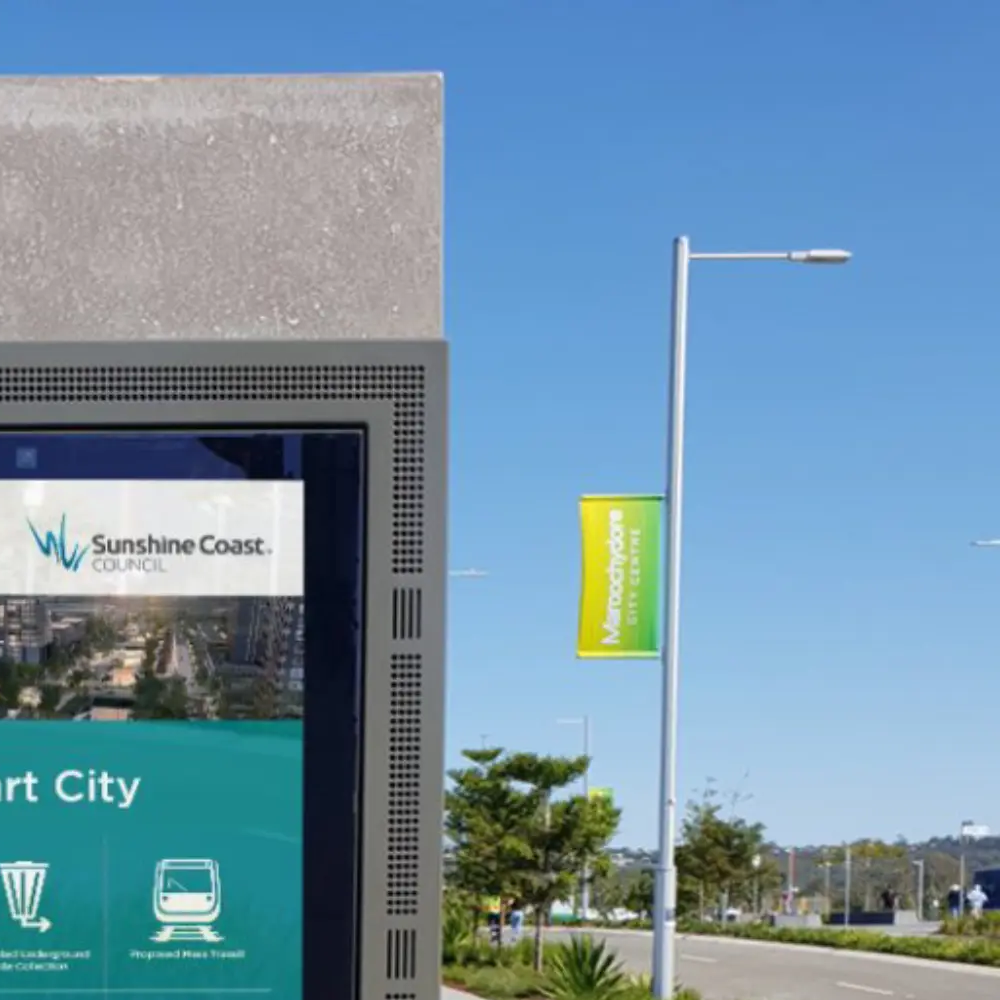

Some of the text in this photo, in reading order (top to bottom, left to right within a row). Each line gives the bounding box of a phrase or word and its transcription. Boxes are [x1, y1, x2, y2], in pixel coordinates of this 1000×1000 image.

[91, 533, 266, 556] Sunshine Coast
[91, 558, 167, 573] COUNCIL
[54, 769, 142, 808] City
